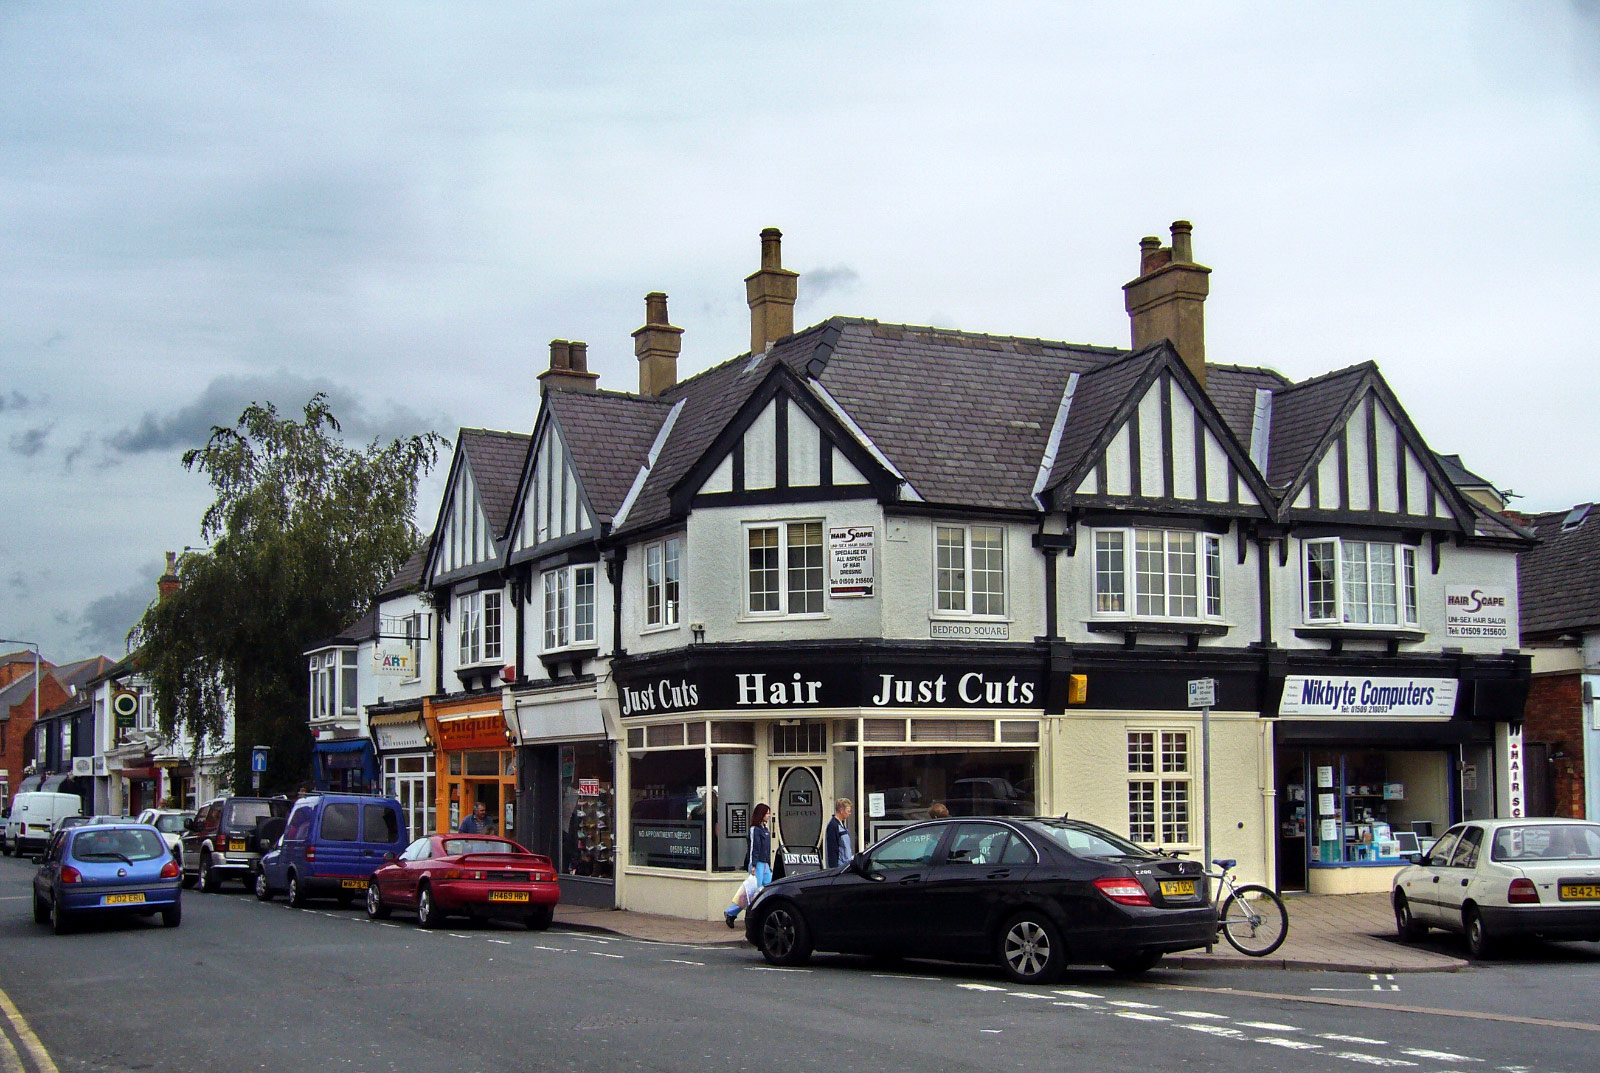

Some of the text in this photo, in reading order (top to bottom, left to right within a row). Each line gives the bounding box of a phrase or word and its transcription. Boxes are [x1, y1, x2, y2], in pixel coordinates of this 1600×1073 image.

[1448, 590, 1504, 614] HAIR SCAPE
[932, 626, 1006, 636] BEDFORD SQUARE
[382, 656, 408, 666] ART
[735, 672, 822, 705] Hair
[872, 672, 1034, 706] Just Cuts
[622, 679, 699, 716] Just Cuts
[1302, 679, 1434, 710] Nikbyte Computers
[580, 786, 598, 794] SALE
[674, 832, 692, 840] NEEDED
[784, 854, 819, 864] JUST CUTS
[1564, 887, 1592, 896] J842
